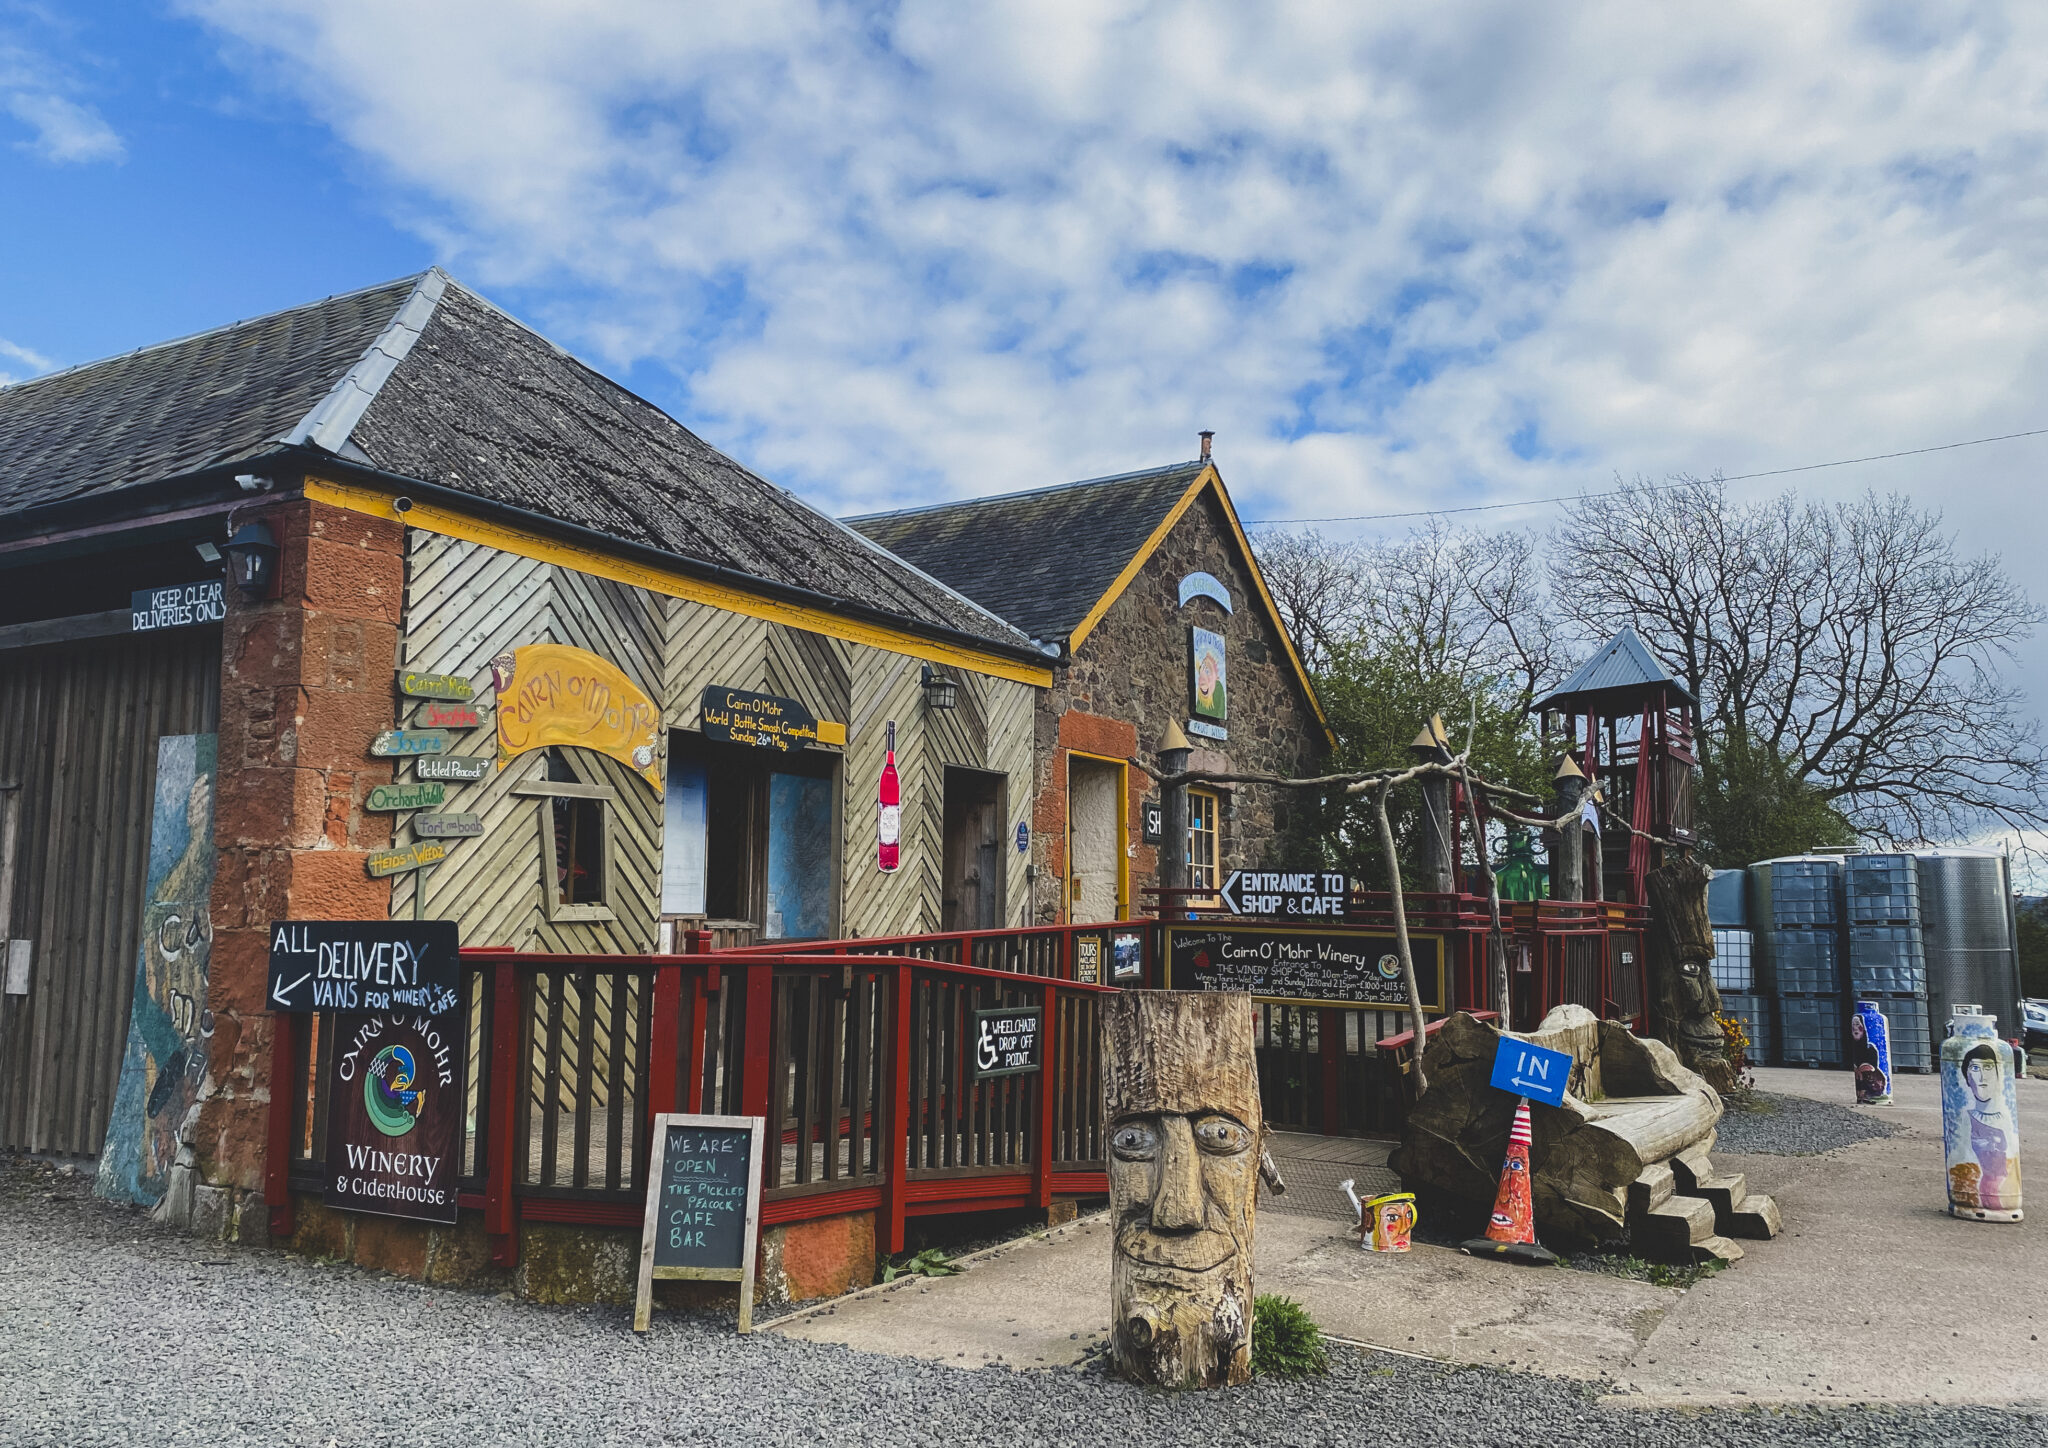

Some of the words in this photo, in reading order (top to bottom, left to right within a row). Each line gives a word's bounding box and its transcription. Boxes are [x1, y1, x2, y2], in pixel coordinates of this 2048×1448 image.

[152, 589, 182, 610] KEEP
[185, 583, 222, 605] CLEAR
[132, 606, 192, 631] DELIVERIES
[196, 601, 227, 622] ONLY
[727, 693, 751, 708] Cairn
[753, 699, 760, 712] O
[762, 701, 783, 716] Mohr
[705, 707, 729, 726] World
[734, 714, 757, 730] Bottle
[758, 718, 780, 733] Smash
[730, 727, 757, 746] Sunday
[418, 760, 450, 777] Pickled
[451, 761, 480, 777] Peacock
[372, 786, 422, 808] Orchard
[1241, 873, 1316, 893] ENTRANCE
[1321, 874, 1344, 893] TO
[1242, 895, 1282, 914] SHOP
[1286, 898, 1301, 914] &
[1301, 896, 1344, 915] CAFE
[273, 925, 316, 953] ALL
[1174, 938, 1206, 949] Welcome
[1206, 934, 1216, 942] To
[1217, 933, 1232, 941] The
[1080, 943, 1097, 956] TOURS
[1222, 942, 1258, 959] Cairn
[1279, 943, 1313, 959] Mohr
[1317, 943, 1365, 971] Winery
[318, 940, 429, 985] DELIVERY
[1216, 964, 1234, 974] THE
[1236, 965, 1268, 975] WINERY
[1270, 966, 1292, 976] SHOP
[1273, 959, 1309, 969] Entrance
[1311, 961, 1322, 969] To
[1284, 977, 1305, 988] Sunday
[313, 981, 358, 1008] VANS
[365, 991, 390, 1009] FOR
[392, 982, 431, 1007] WINERY
[429, 989, 457, 1015] CAFE
[992, 1018, 1036, 1034] WHEELCHAIR
[340, 1015, 383, 1081] CAIRN
[412, 1015, 452, 1088] MOHR
[999, 1036, 1017, 1051] DROP
[1020, 1035, 1034, 1049] OFF
[1517, 1052, 1549, 1080] IN
[670, 1135, 693, 1153] WE
[700, 1138, 733, 1154] ARE
[674, 1158, 716, 1174] OPEN
[337, 1175, 348, 1192] &
[668, 1184, 691, 1195] THE
[698, 1183, 745, 1196] PICKLED
[688, 1195, 734, 1211] PEACOCK
[670, 1210, 716, 1227] CAFE
[670, 1227, 706, 1248] BAR
